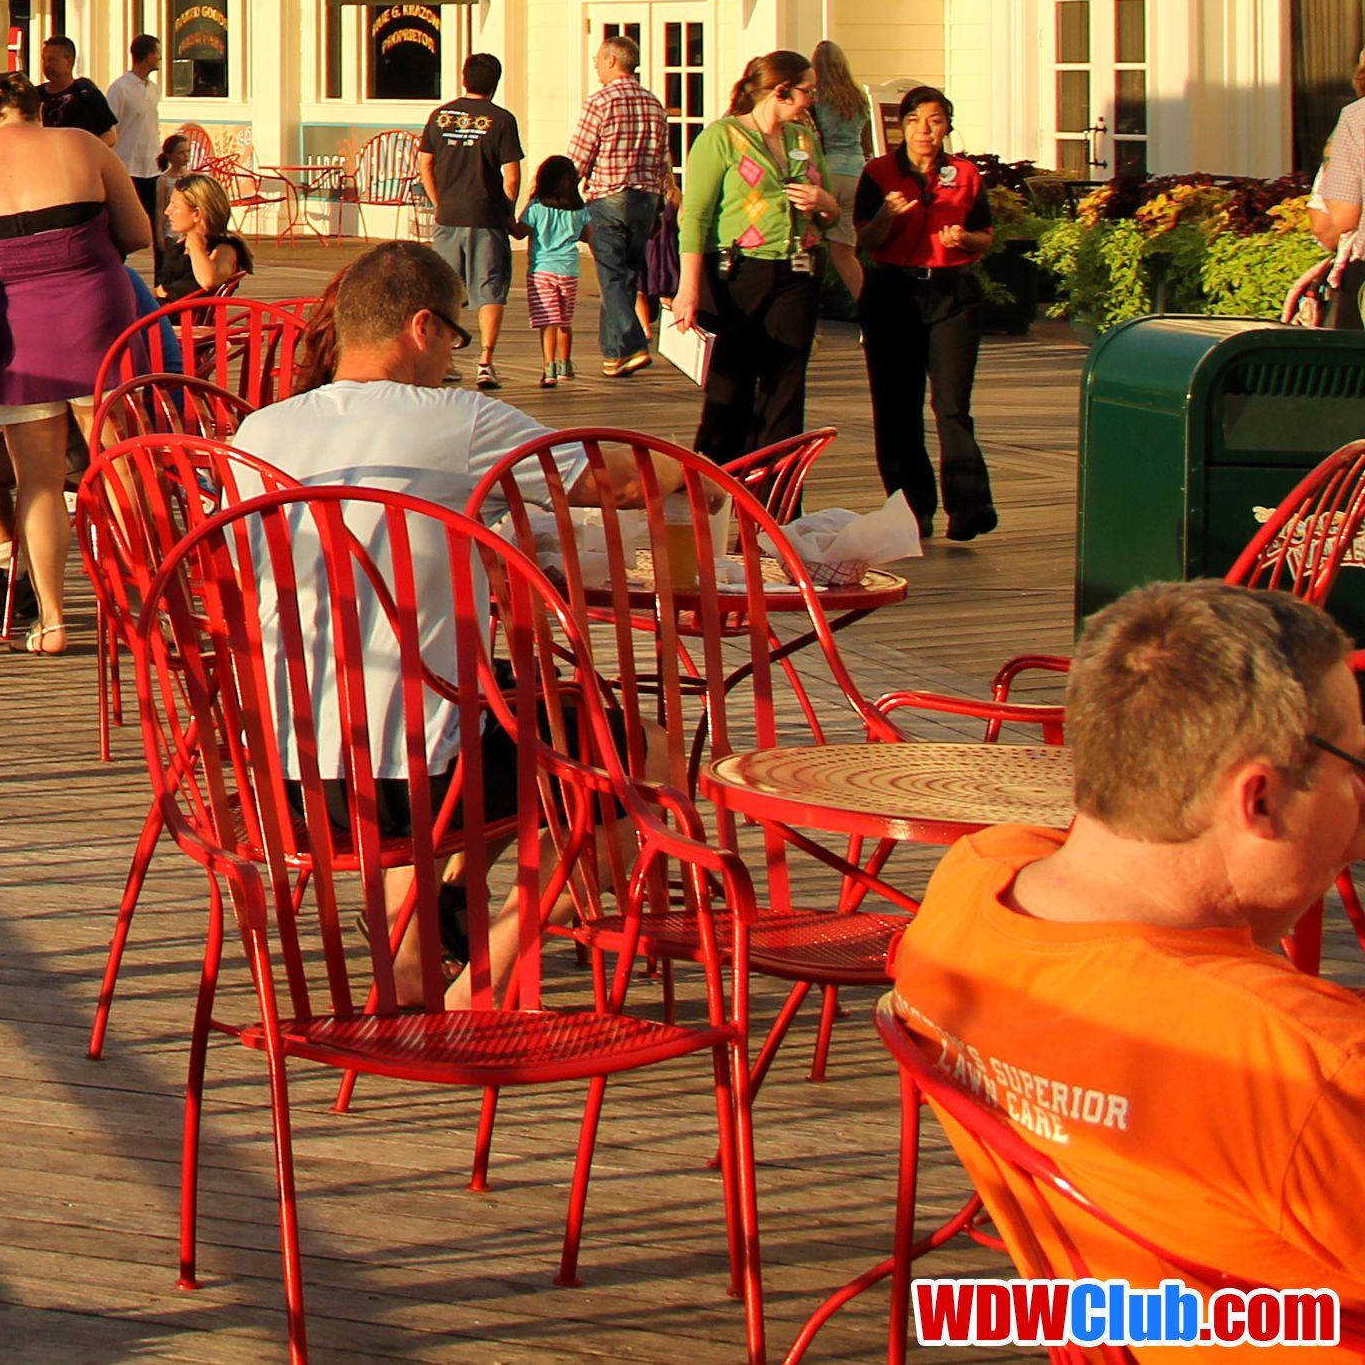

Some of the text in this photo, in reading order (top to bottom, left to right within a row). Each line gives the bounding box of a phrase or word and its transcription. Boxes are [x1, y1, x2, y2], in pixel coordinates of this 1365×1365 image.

[936, 1038, 1070, 1144] LAWN CARE
[989, 1056, 1129, 1130] SUPERIOR
